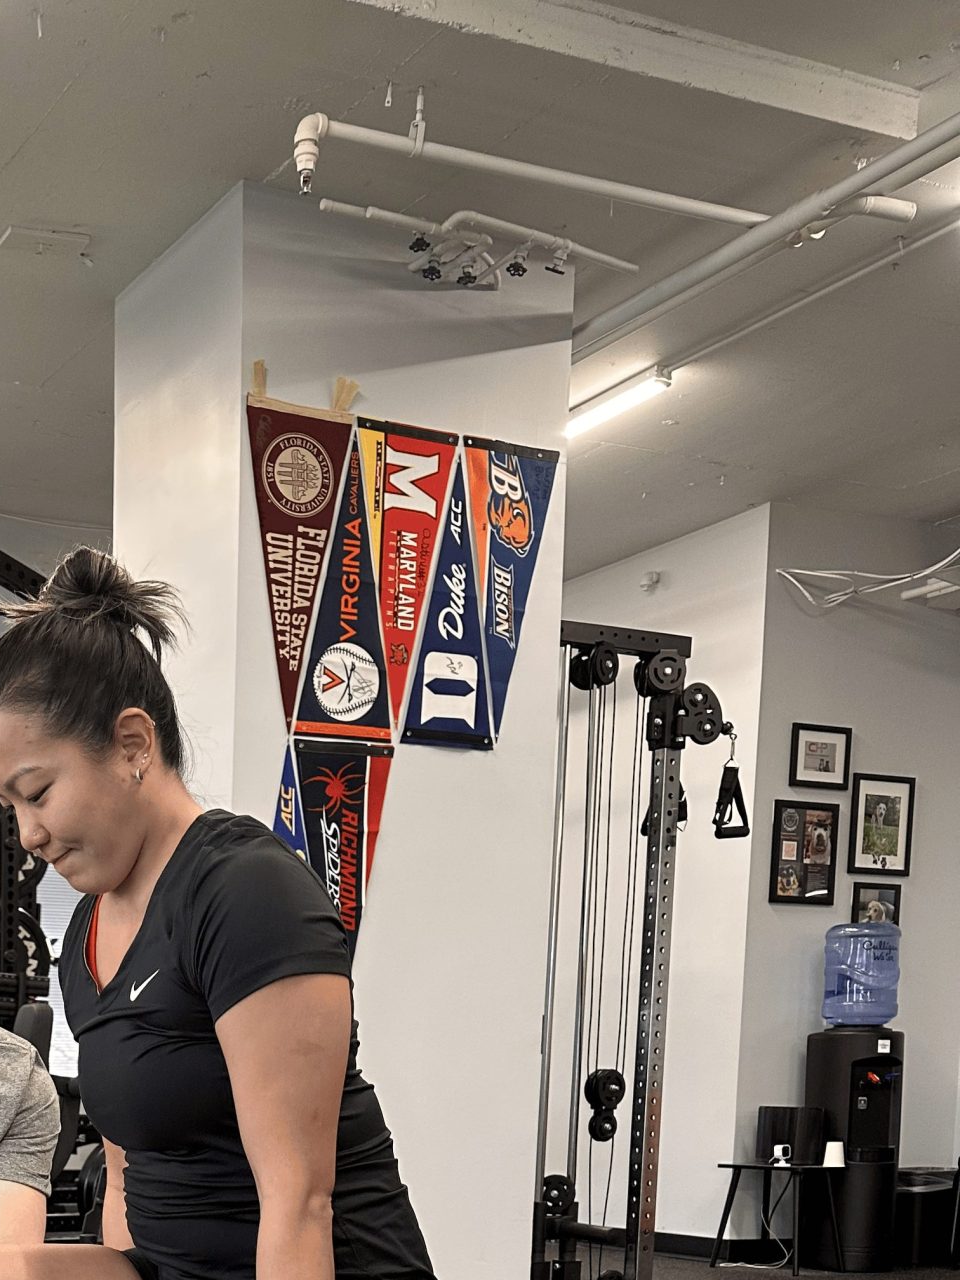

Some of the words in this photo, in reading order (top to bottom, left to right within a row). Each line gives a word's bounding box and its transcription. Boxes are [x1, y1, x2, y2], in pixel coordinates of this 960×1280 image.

[266, 462, 274, 482] 1851
[280, 438, 318, 454] FLORIDA
[318, 454, 330, 486] STATE
[281, 488, 329, 512] UNIVERSITY
[349, 452, 359, 515] CAVALIERS
[384, 444, 439, 519] M
[450, 497, 463, 545] ACC
[266, 532, 294, 660] UNIVERSITY
[292, 525, 328, 609] FLORIDA
[340, 518, 361, 641] VIRGINIA
[386, 530, 397, 629] TERRAPINS
[398, 531, 418, 631] MARYLAND
[438, 563, 467, 640] Duke
[493, 565, 512, 637] BISON
[289, 613, 308, 671] STATE
[281, 784, 293, 831] ACC
[341, 808, 359, 931] RICHMOND
[18, 925, 38, 977] TAN
